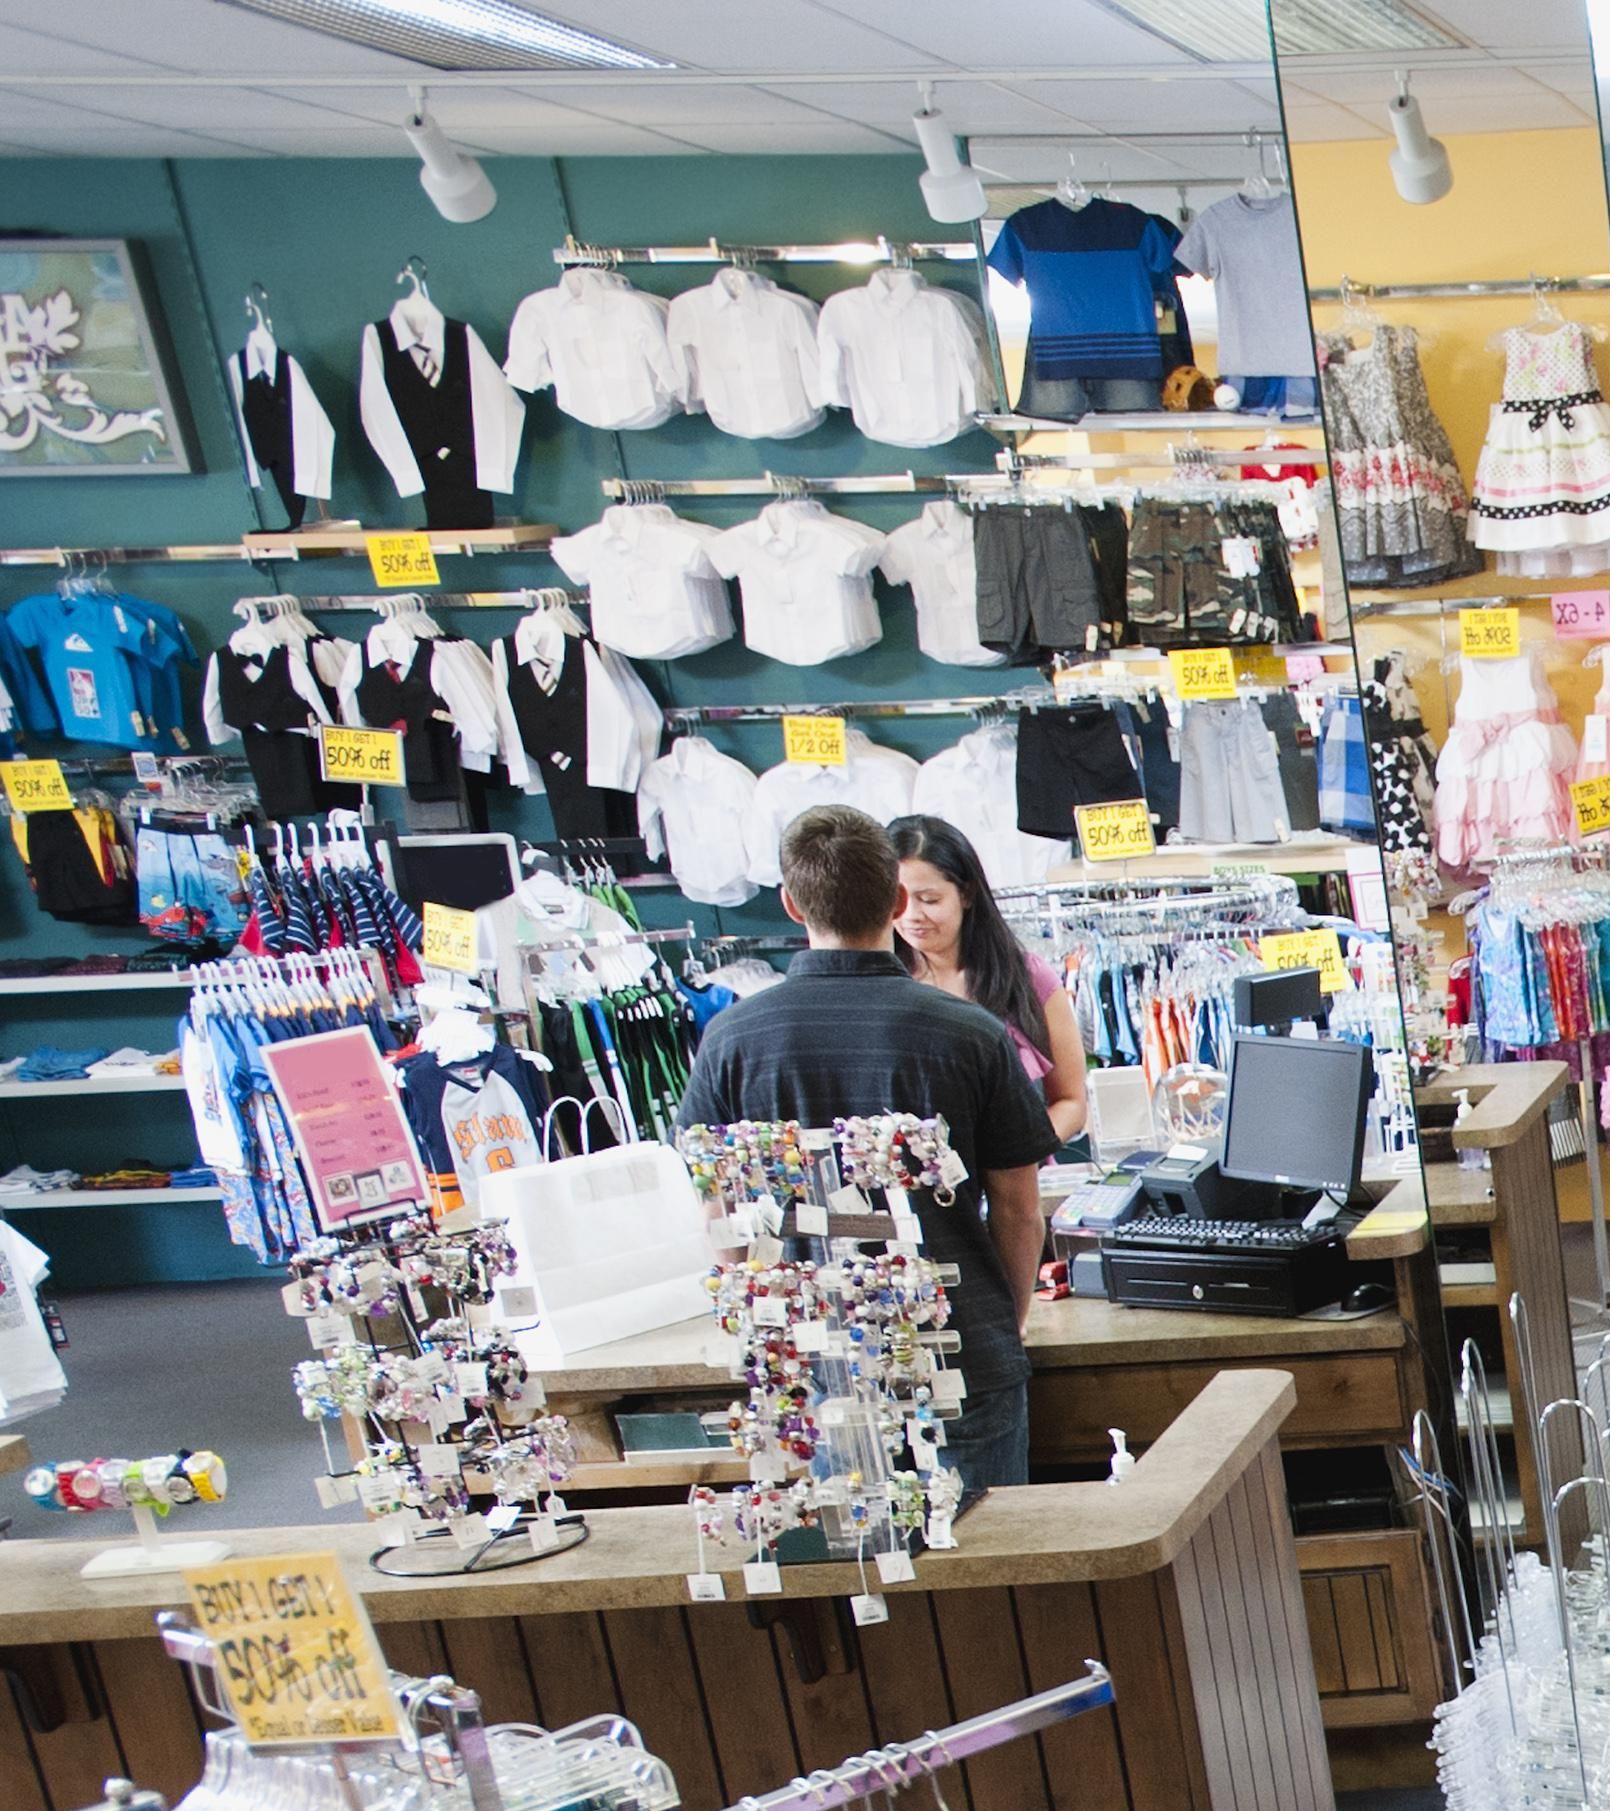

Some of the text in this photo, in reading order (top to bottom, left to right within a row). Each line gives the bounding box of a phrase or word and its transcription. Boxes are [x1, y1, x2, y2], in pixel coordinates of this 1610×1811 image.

[381, 552, 413, 573] 50%
[1183, 665, 1211, 686] 50%
[791, 738, 841, 754] 1/2 Off
[327, 746, 390, 770] 50% off
[14, 779, 46, 798] 50%
[1088, 821, 1147, 847] 50% off
[194, 1580, 250, 1624] BUY
[268, 1574, 317, 1619] GET
[219, 1629, 367, 1706] 50% off
